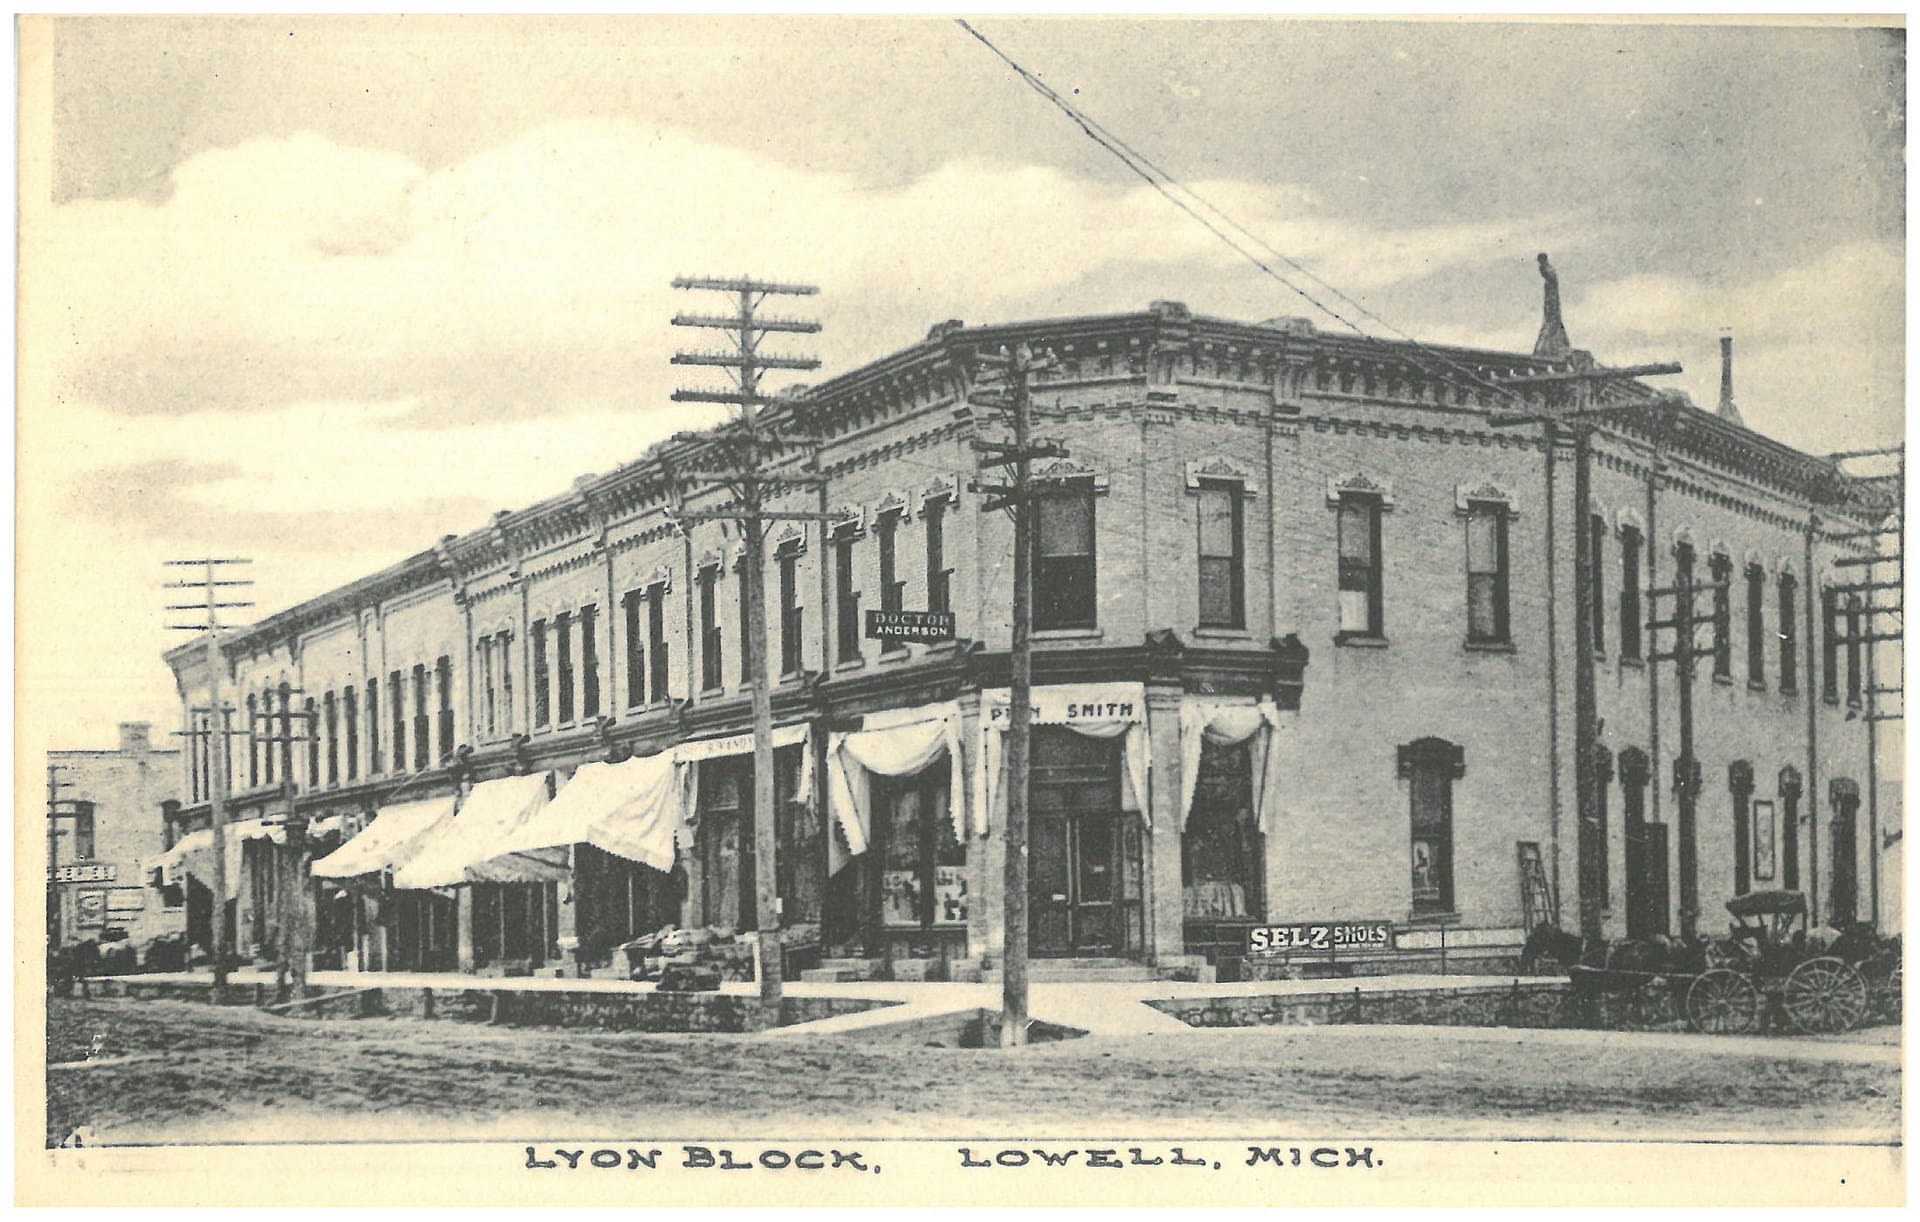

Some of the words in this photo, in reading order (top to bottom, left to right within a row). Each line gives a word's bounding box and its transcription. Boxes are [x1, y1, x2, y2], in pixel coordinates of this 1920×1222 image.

[875, 613, 949, 626] DOCTOR
[876, 626, 947, 636] ANDERSON
[1067, 703, 1133, 719] SMITH
[1250, 926, 1330, 951] SELZ
[1334, 925, 1387, 943] SHOES
